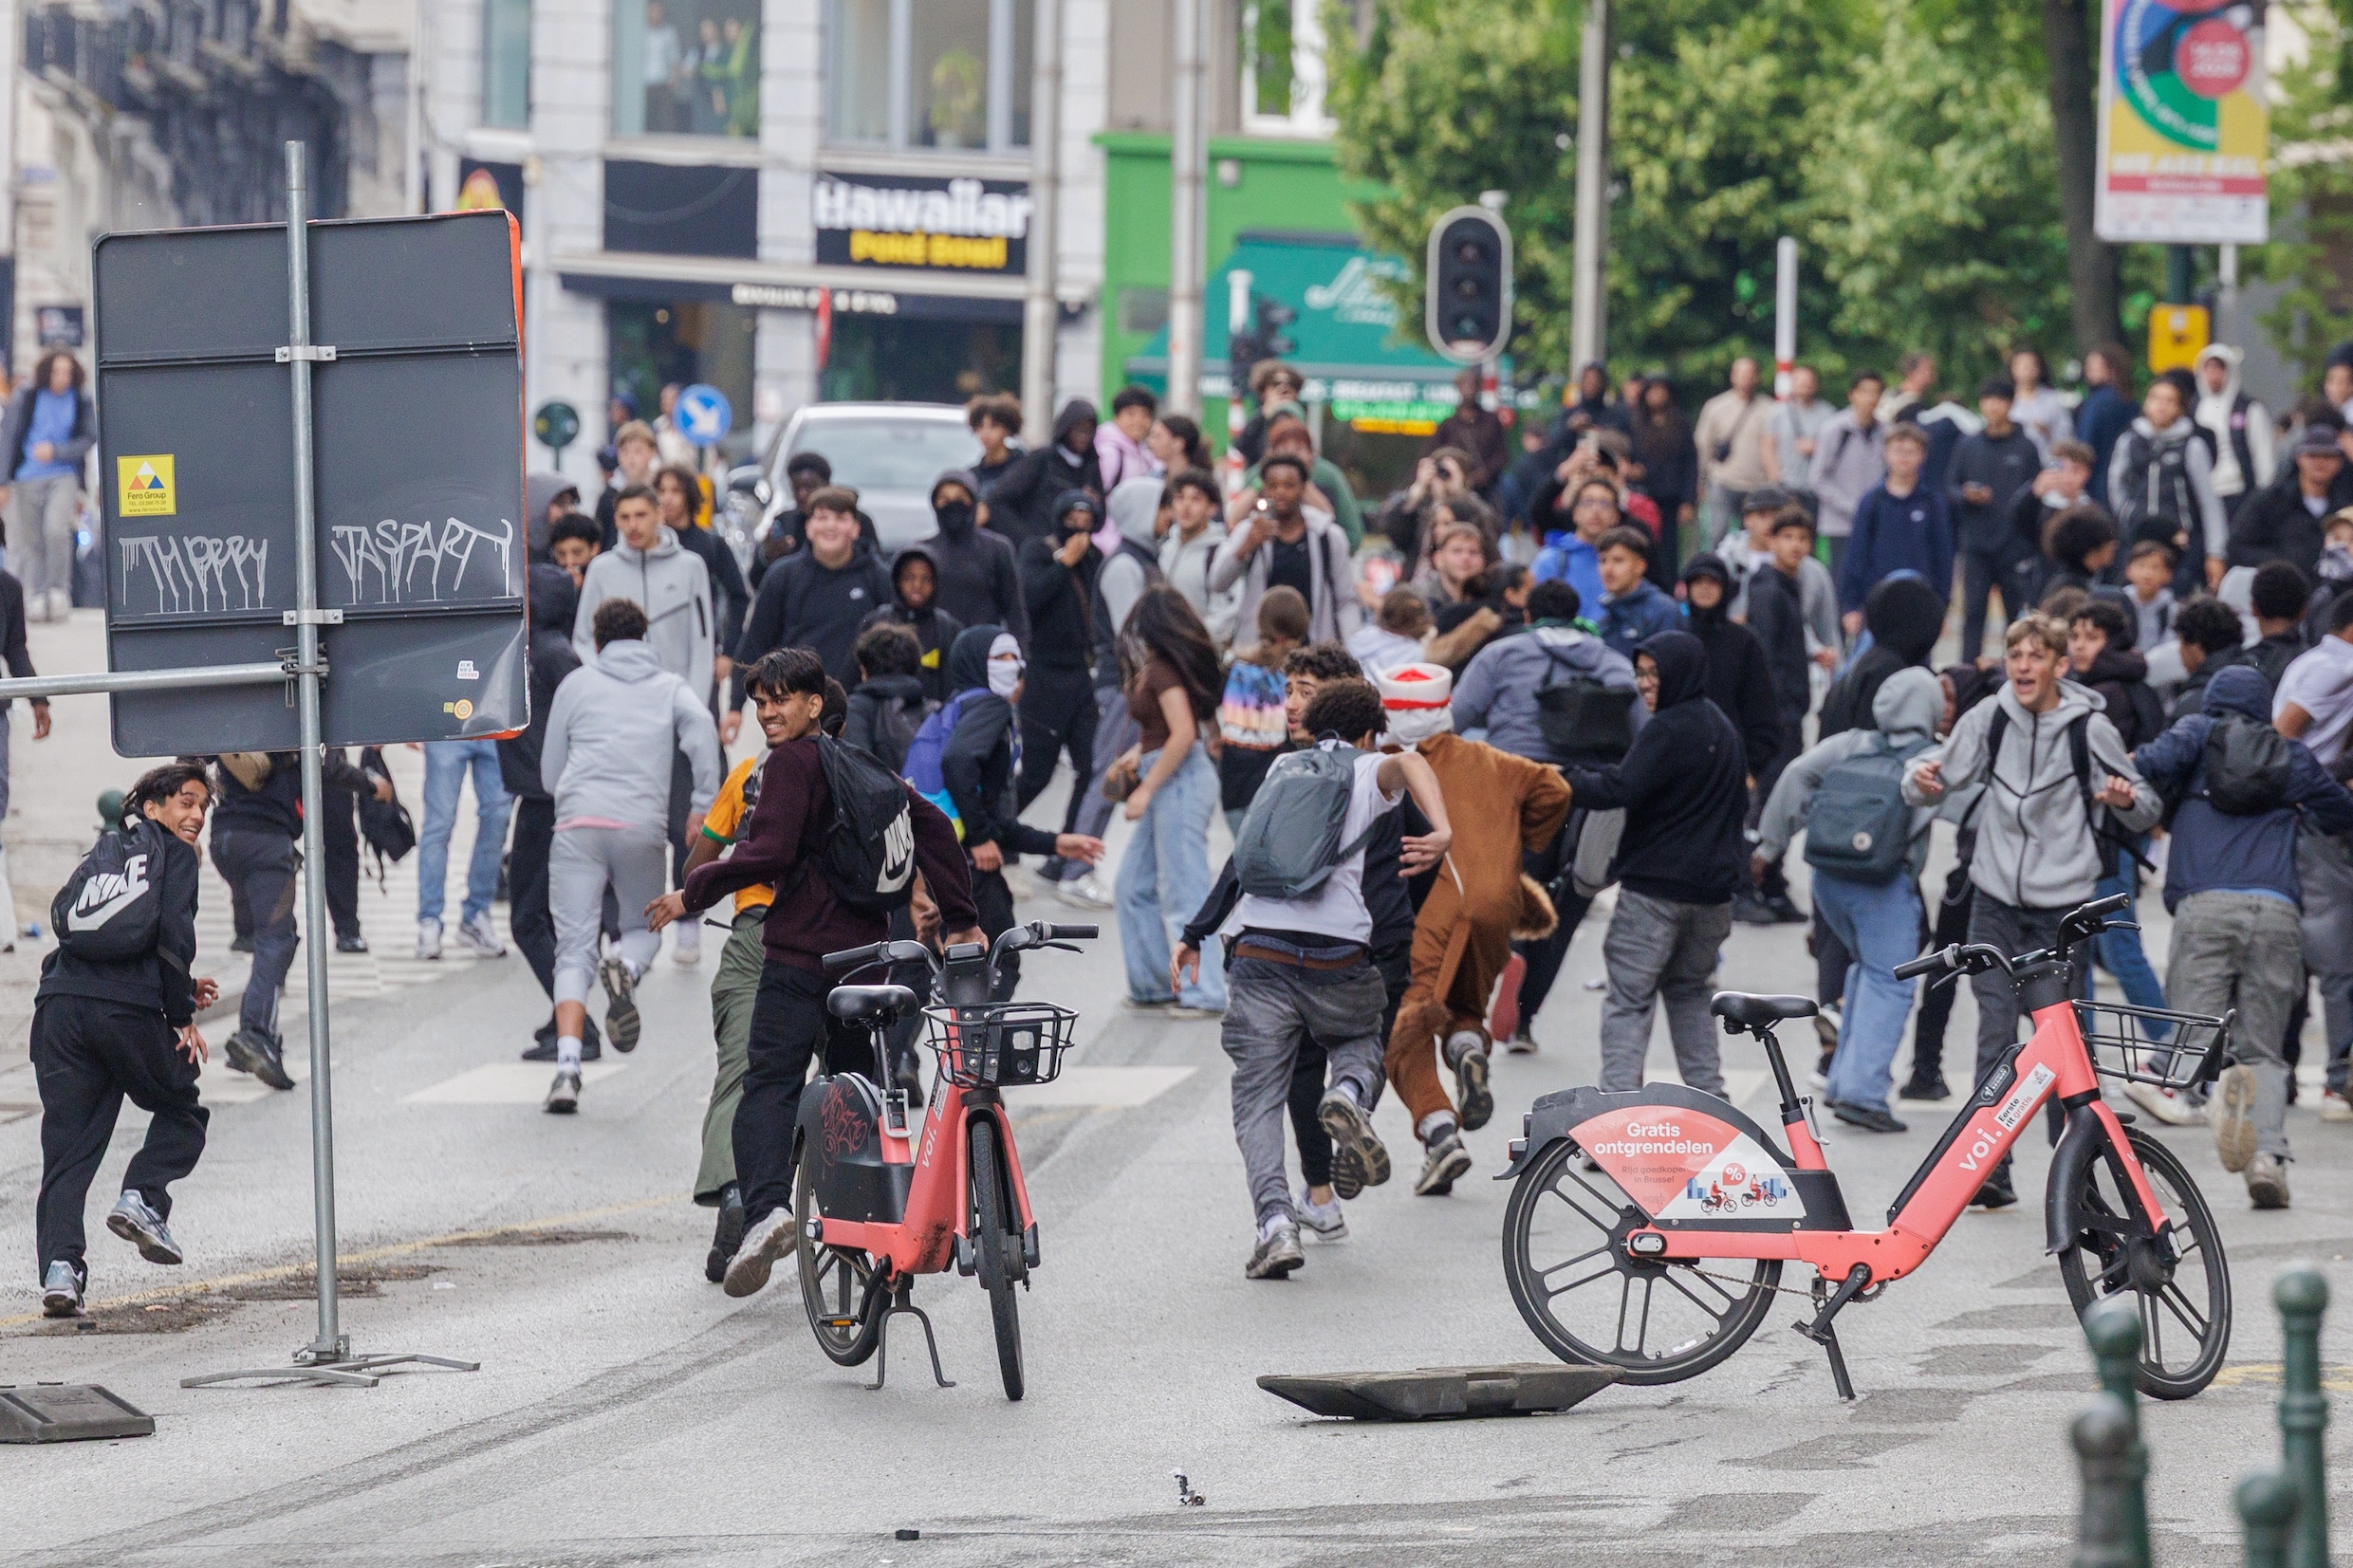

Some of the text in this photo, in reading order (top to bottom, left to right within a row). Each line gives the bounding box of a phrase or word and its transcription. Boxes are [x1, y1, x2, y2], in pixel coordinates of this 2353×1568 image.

[144, 491, 167, 500] Group
[77, 854, 148, 911] NIKE
[1998, 1098, 2020, 1122] Eerste
[2006, 1096, 2032, 1128] rit gratis
[1627, 1122, 1680, 1137] Gratis
[1594, 1140, 1713, 1158] ontgrendelen
[1621, 1166, 1638, 1174] Rijd
